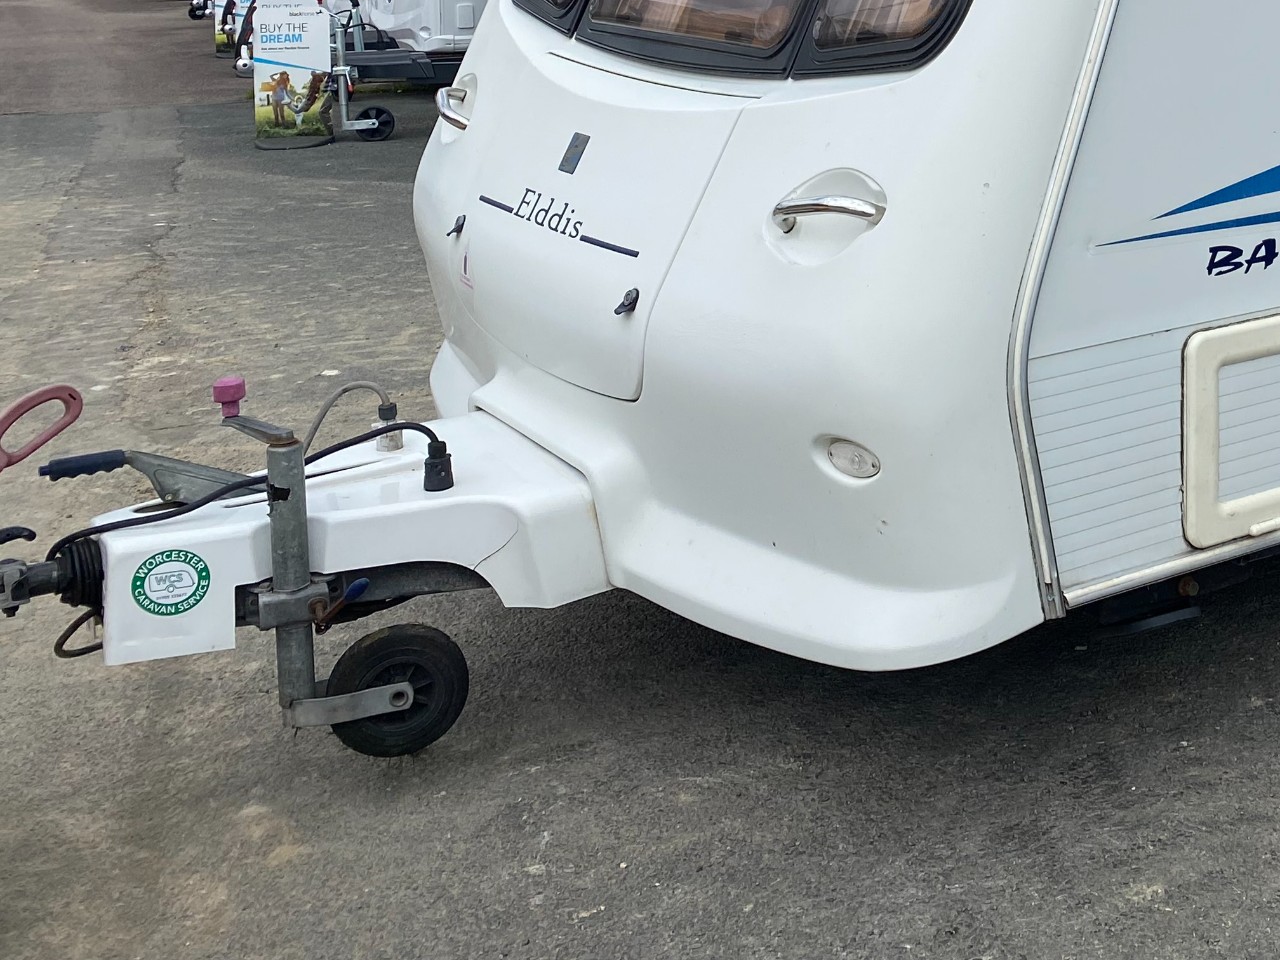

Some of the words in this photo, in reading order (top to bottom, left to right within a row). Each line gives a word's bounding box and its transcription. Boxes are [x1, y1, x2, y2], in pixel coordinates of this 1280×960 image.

[260, 23, 283, 34] BUY
[286, 22, 308, 33] THE
[260, 34, 303, 44] DREAM
[513, 188, 583, 239] Elddis
[136, 551, 205, 578] WORCESTER
[155, 573, 183, 586] WCS
[135, 588, 175, 614] CARAVAN
[177, 580, 208, 612] SERVICE
